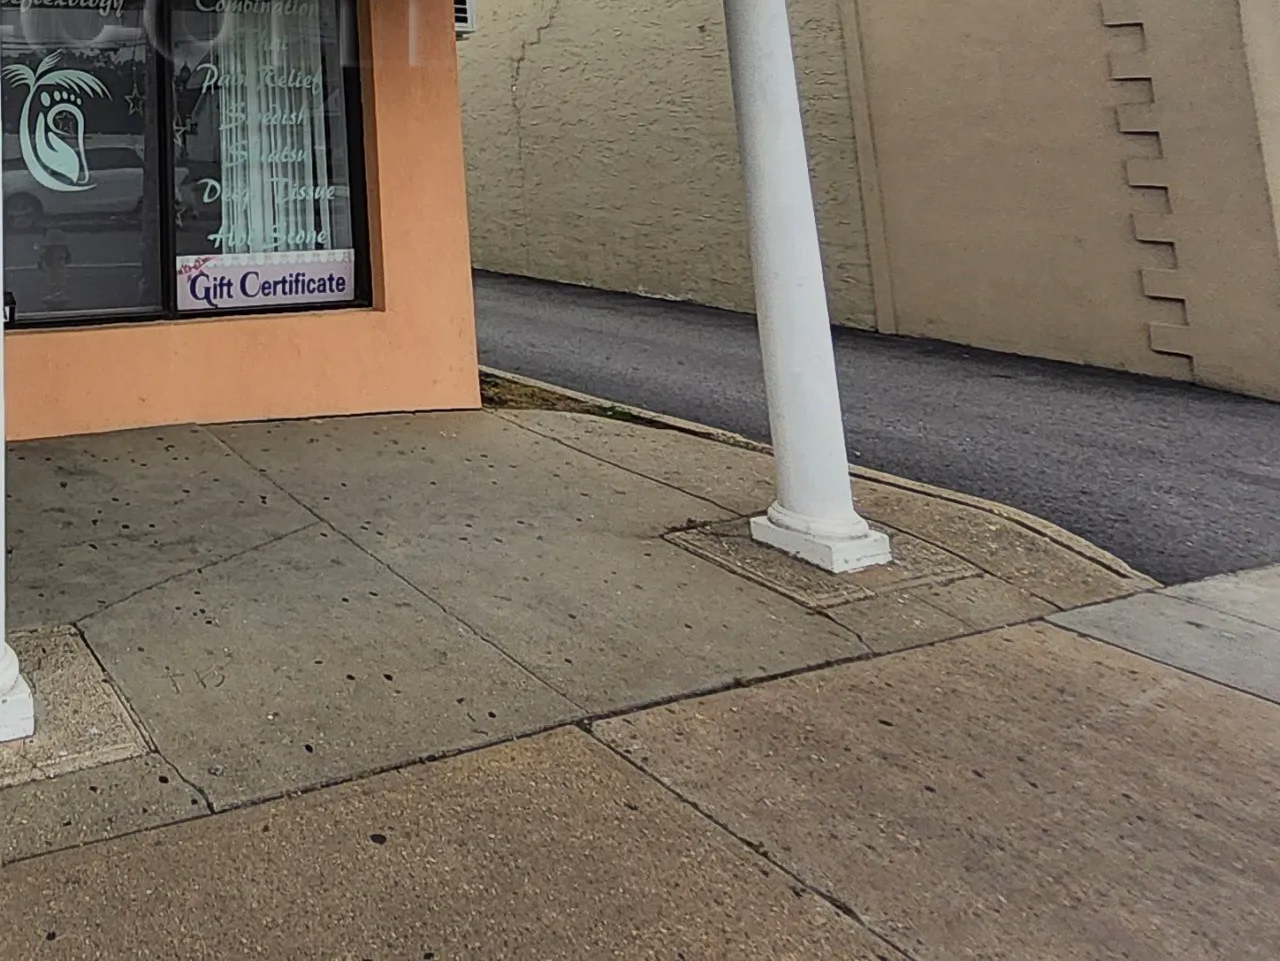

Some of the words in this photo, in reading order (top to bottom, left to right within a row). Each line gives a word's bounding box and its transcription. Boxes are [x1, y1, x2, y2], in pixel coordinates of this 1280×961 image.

[218, 101, 308, 131] Sedish
[189, 270, 234, 309] Gift
[239, 270, 347, 299] Certificate
